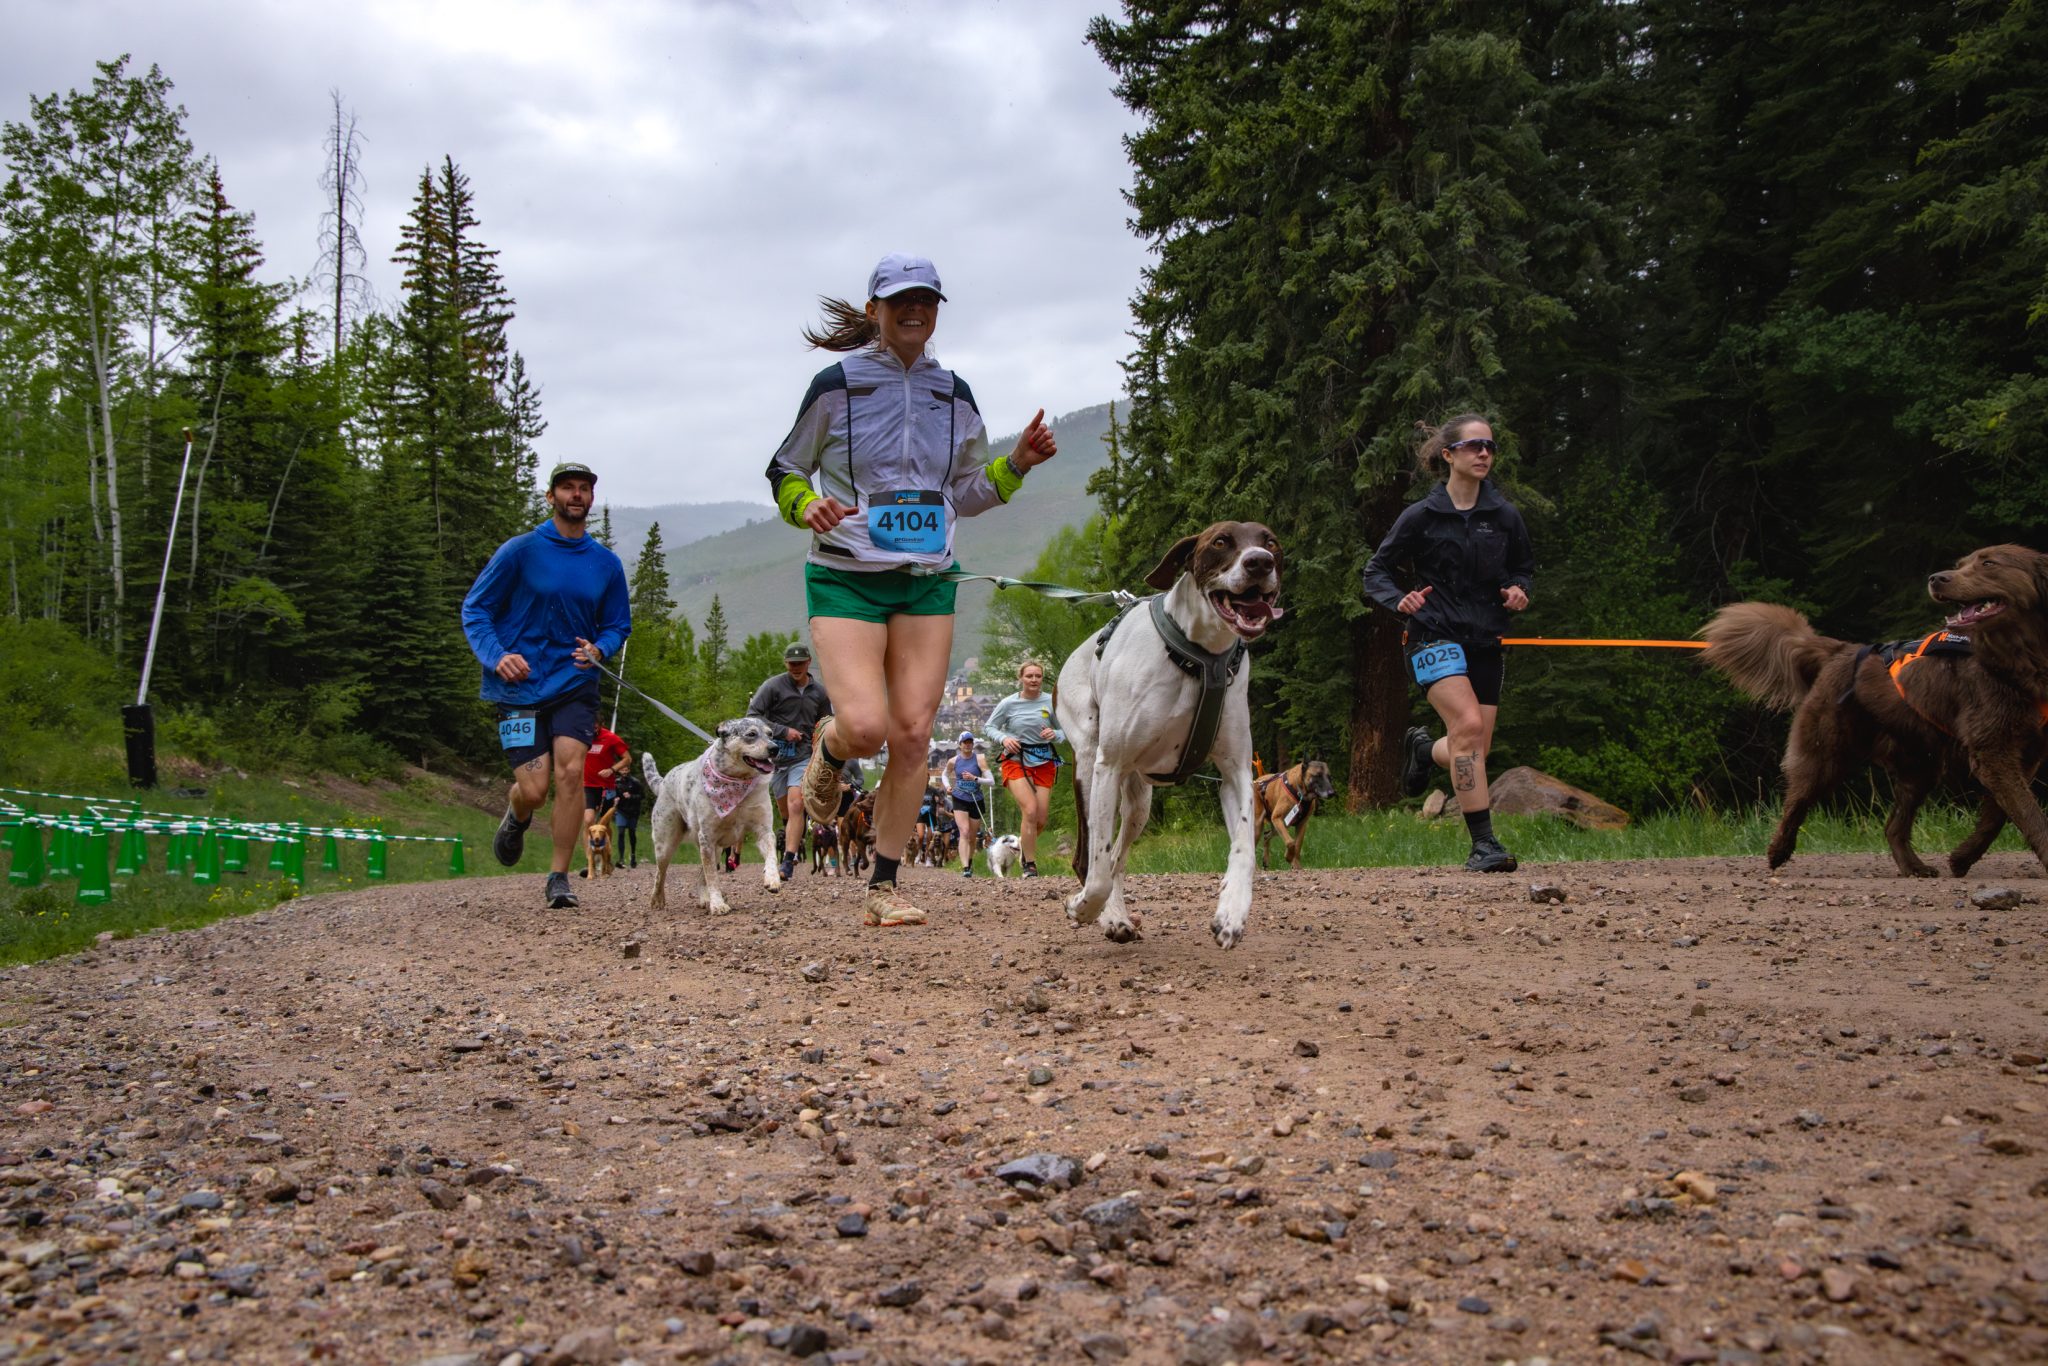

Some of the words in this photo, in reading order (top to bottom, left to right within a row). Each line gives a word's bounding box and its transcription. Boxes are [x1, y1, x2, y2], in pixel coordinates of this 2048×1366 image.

[877, 511, 938, 532] 4104
[1417, 647, 1460, 670] 4025
[501, 722, 531, 736] 4046
